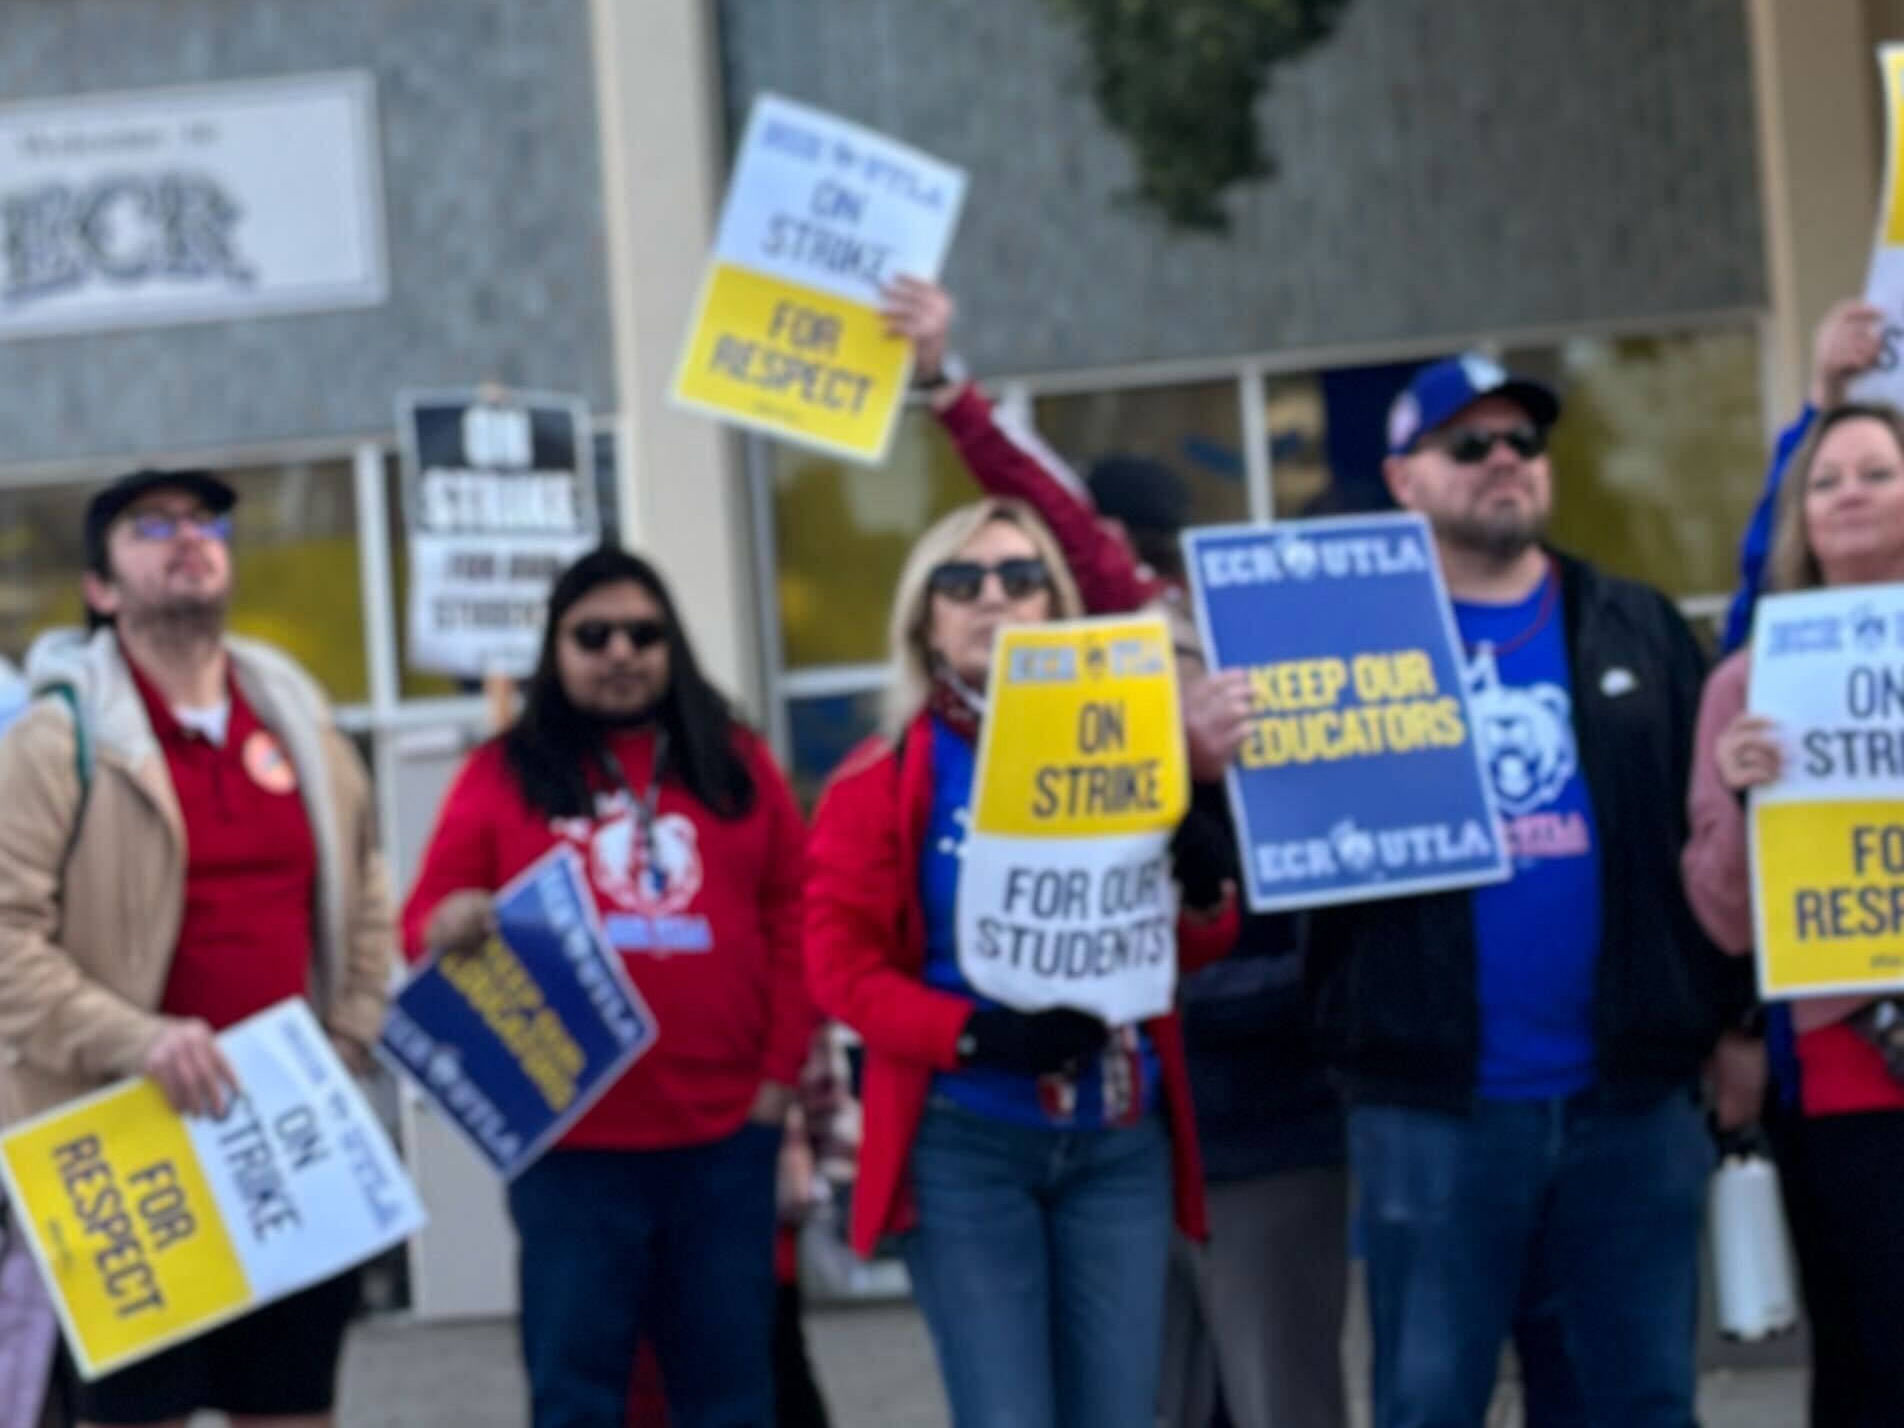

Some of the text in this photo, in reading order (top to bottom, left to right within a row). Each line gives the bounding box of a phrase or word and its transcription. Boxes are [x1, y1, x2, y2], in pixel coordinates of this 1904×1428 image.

[809, 177, 865, 227] ON
[761, 212, 891, 289] STRIKE
[769, 299, 845, 357] FOR
[709, 333, 873, 417] RESPECT
[1201, 533, 1427, 587] ECR UTLA
[1251, 649, 1437, 712] KEEP OUR
[1077, 701, 1125, 755] ON
[1240, 697, 1466, 769] EDUCATORS
[1031, 760, 1164, 821] STRIKE
[1257, 842, 1332, 884] ECR
[1379, 818, 1493, 861] UTLA
[1003, 859, 1159, 922] FOR OUR
[976, 914, 1167, 979] STUDENTS
[214, 1088, 304, 1245] STRIKE
[274, 1101, 332, 1172] ON
[52, 1133, 167, 1320] RESPECT
[128, 1158, 199, 1253] FOR
